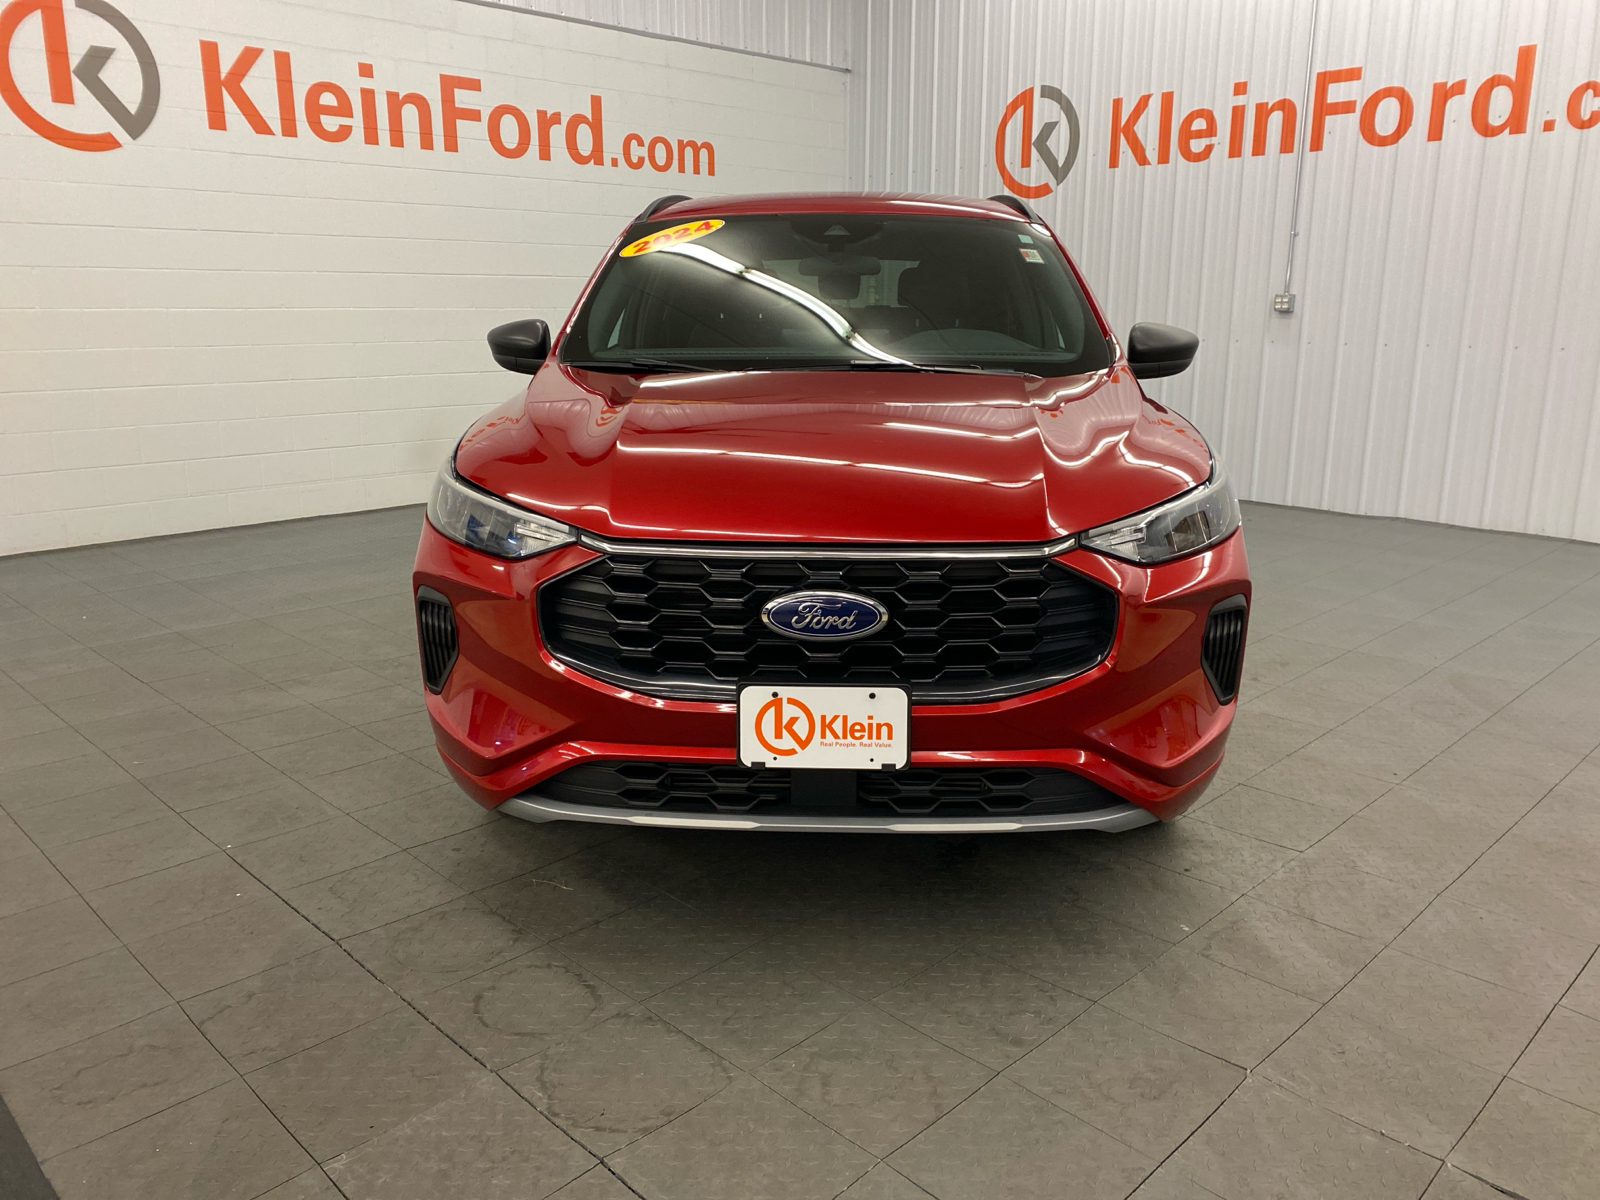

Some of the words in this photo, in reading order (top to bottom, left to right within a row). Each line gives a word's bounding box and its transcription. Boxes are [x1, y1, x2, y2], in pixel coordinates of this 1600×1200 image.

[199, 39, 716, 177] KleinFord.com
[633, 221, 713, 254] 2024
[791, 602, 858, 630] Ford
[820, 714, 893, 740] Klein
